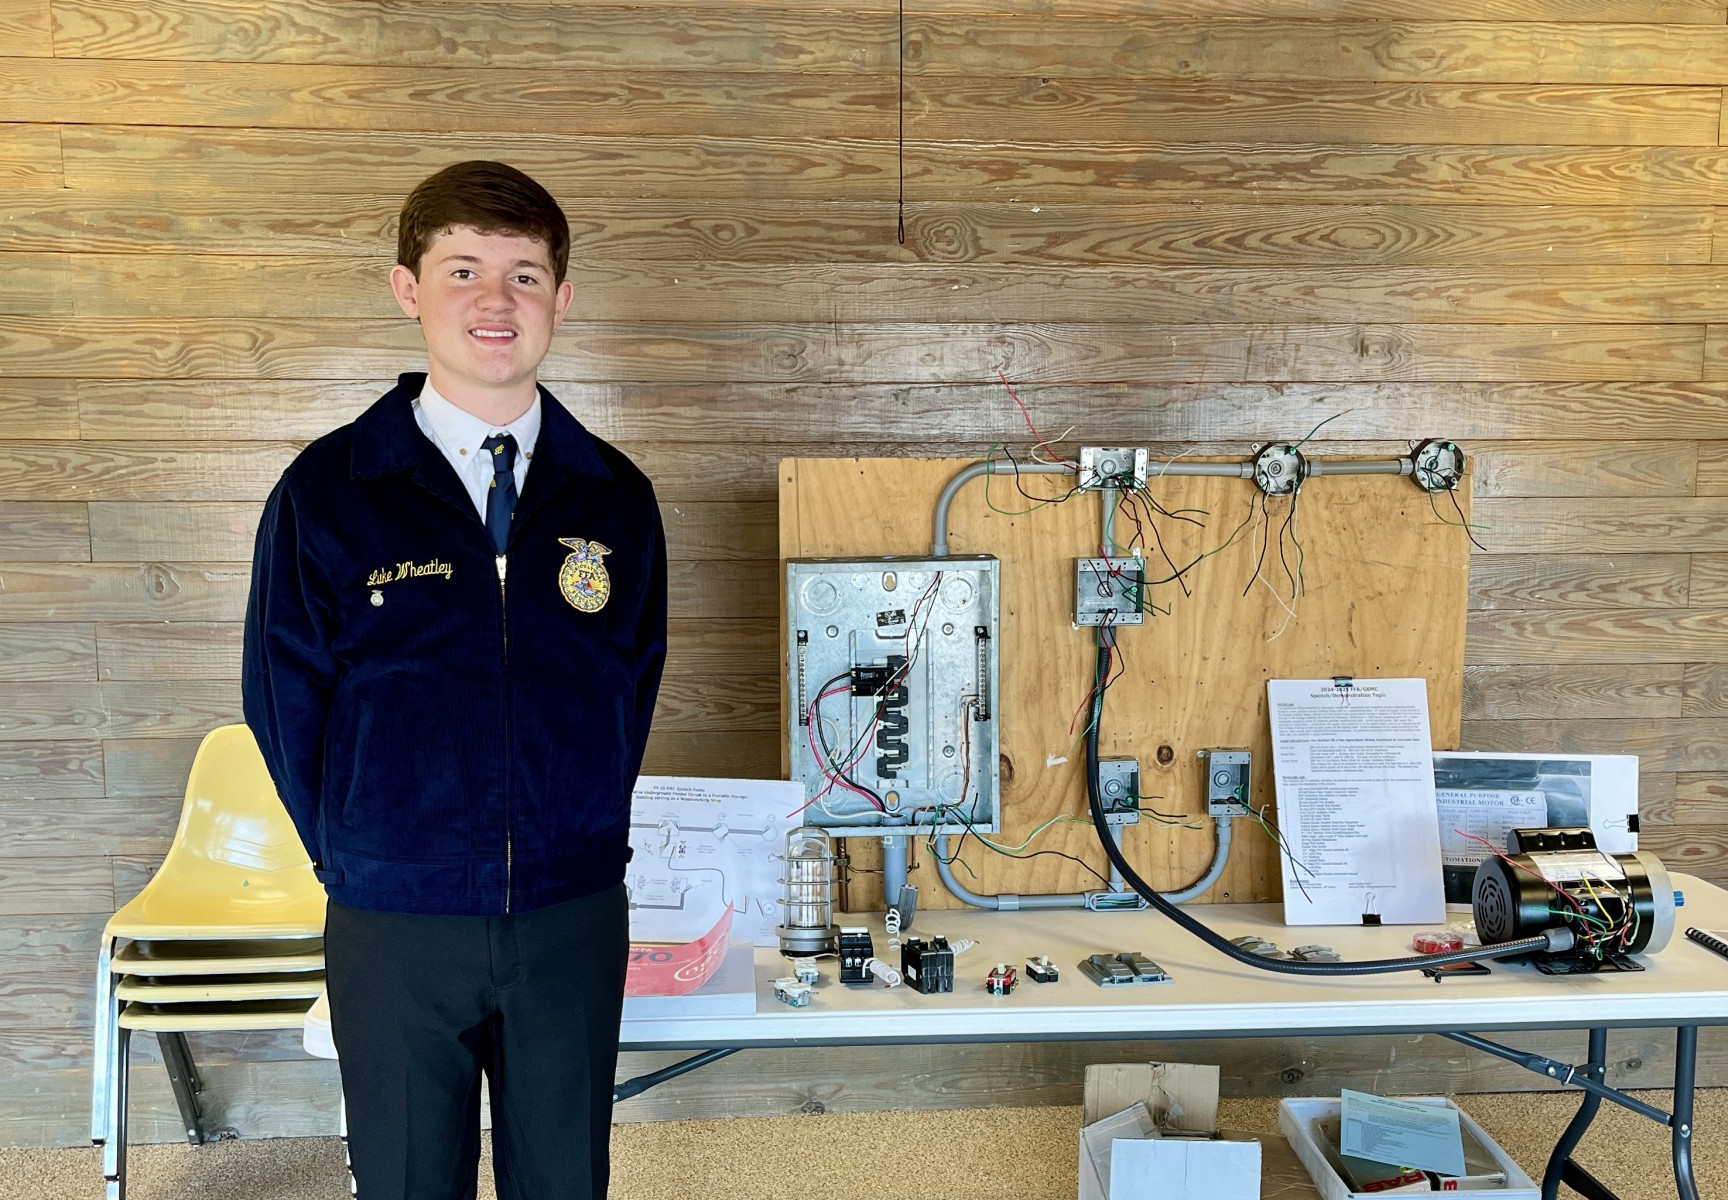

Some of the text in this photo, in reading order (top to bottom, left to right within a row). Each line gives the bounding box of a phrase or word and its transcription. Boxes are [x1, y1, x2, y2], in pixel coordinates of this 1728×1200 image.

[367, 558, 453, 586] Luke Wheatley
[579, 571, 595, 580] FFA
